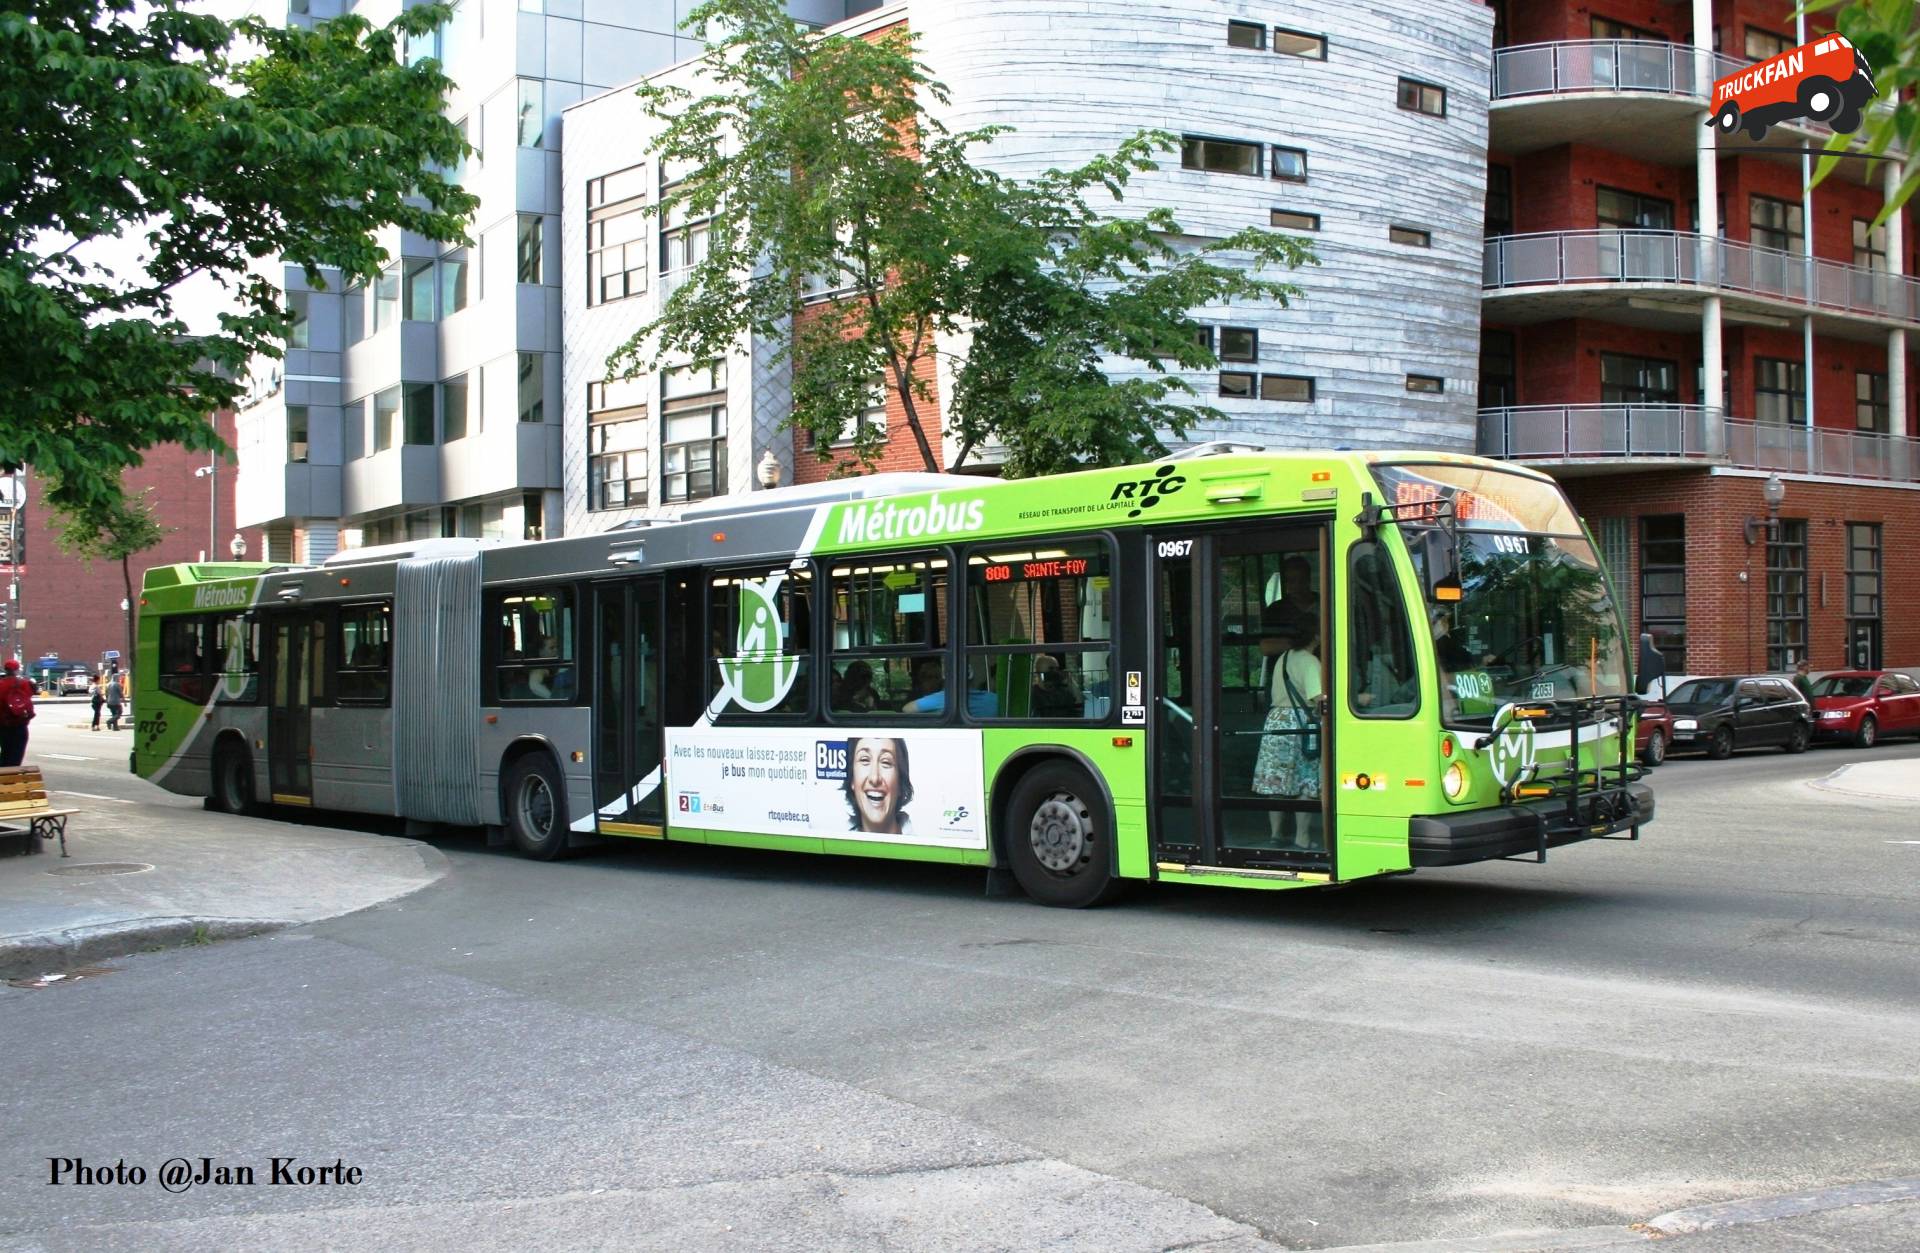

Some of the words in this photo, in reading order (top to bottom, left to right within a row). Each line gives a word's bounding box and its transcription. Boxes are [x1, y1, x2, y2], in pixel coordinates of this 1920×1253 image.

[1110, 476, 1186, 500] RTC
[1051, 505, 1086, 516] TRANSPORT
[1086, 504, 1096, 512] DE
[1096, 503, 1105, 511] LA
[1106, 500, 1135, 510] CAPITALE
[838, 493, 985, 544] Métrobus
[1157, 539, 1193, 558] 0967
[1494, 535, 1530, 554] 0967
[985, 566, 1010, 581] 800
[1023, 560, 1087, 577] SAINTE-FOY
[193, 582, 248, 608] Métrobus
[1455, 674, 1479, 699] 800
[1532, 684, 1553, 697] 2053
[138, 720, 168, 734] RTC
[673, 744, 692, 758] Avec
[693, 745, 705, 758] les
[706, 749, 745, 760] nouveaux
[746, 747, 807, 764] laissez-passer
[817, 743, 847, 770] Bus
[721, 763, 730, 779] je
[731, 764, 746, 777] bus
[747, 767, 766, 779] mon
[767, 765, 807, 781] quotidien
[768, 811, 810, 822] rtcquebec.ca
